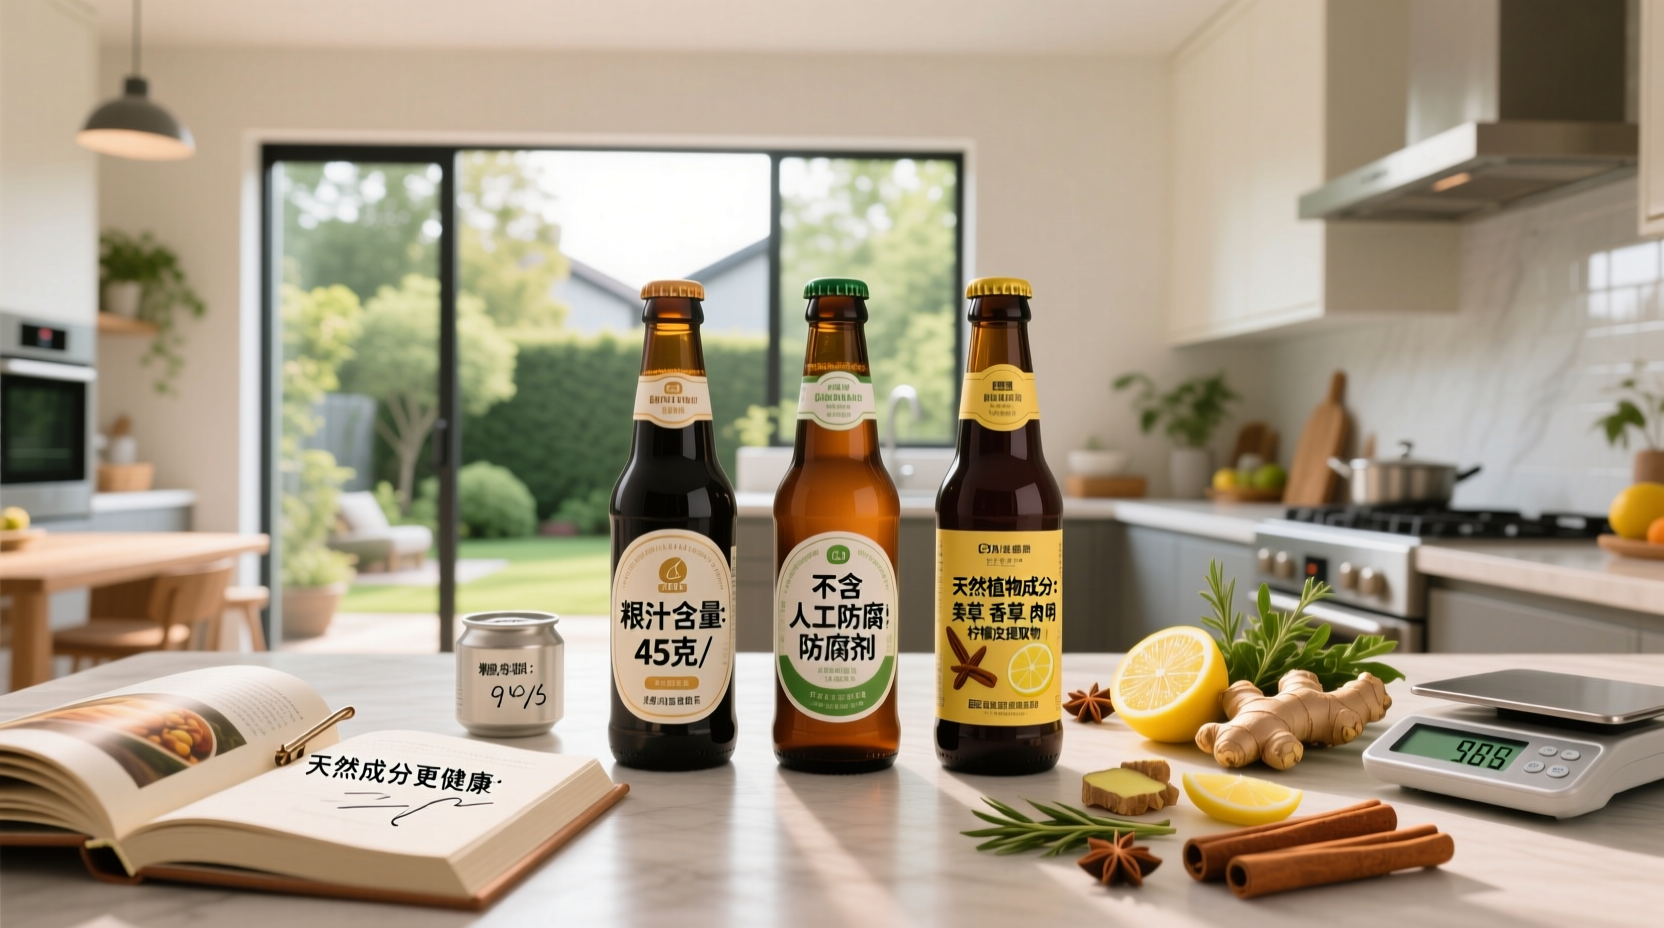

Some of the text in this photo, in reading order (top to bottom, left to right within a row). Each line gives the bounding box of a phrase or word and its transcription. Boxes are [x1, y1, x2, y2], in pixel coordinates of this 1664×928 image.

[812, 573, 863, 600] 不含
[634, 635, 713, 669] 45克/
[799, 632, 876, 662] 防腐剂
